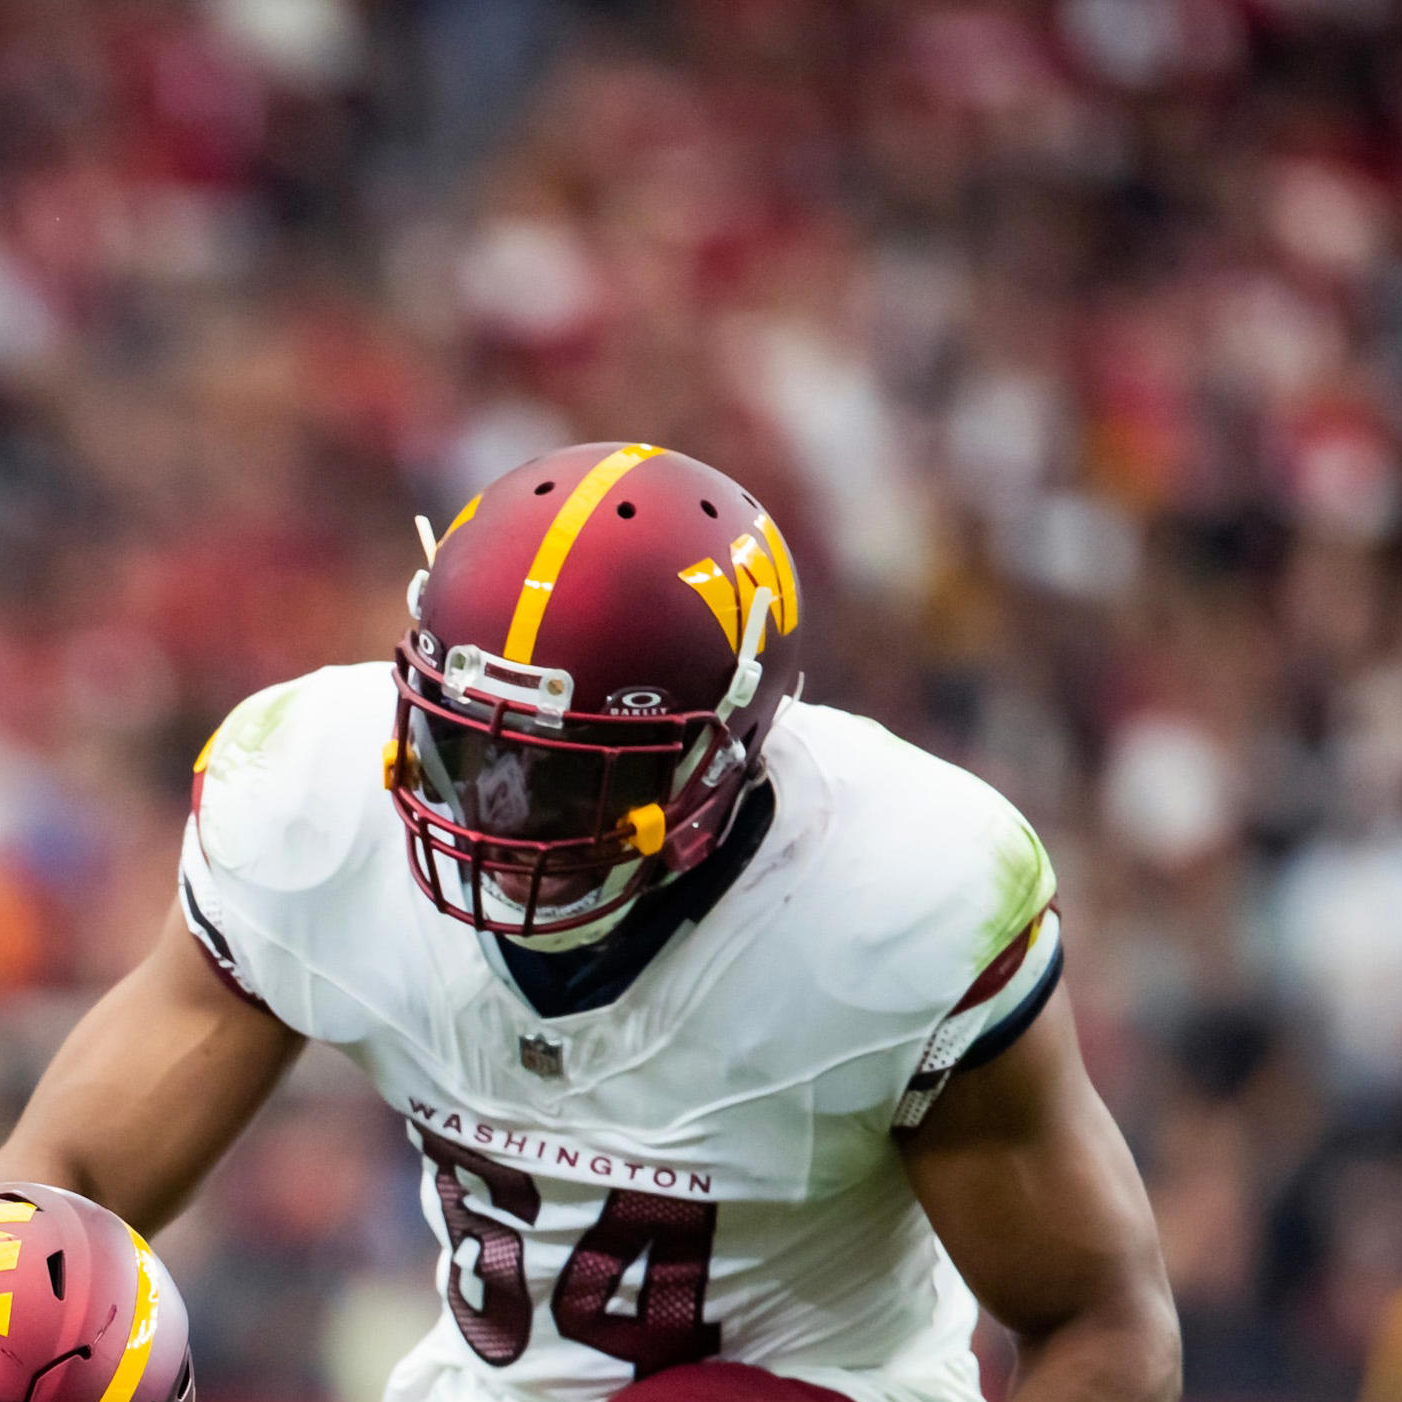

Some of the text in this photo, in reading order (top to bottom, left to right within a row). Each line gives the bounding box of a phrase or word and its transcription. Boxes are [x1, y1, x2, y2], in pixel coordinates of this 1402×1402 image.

[609, 706, 668, 717] OAKLEY
[407, 1096, 712, 1195] WASHINGTON
[421, 1124, 722, 1381] 64
